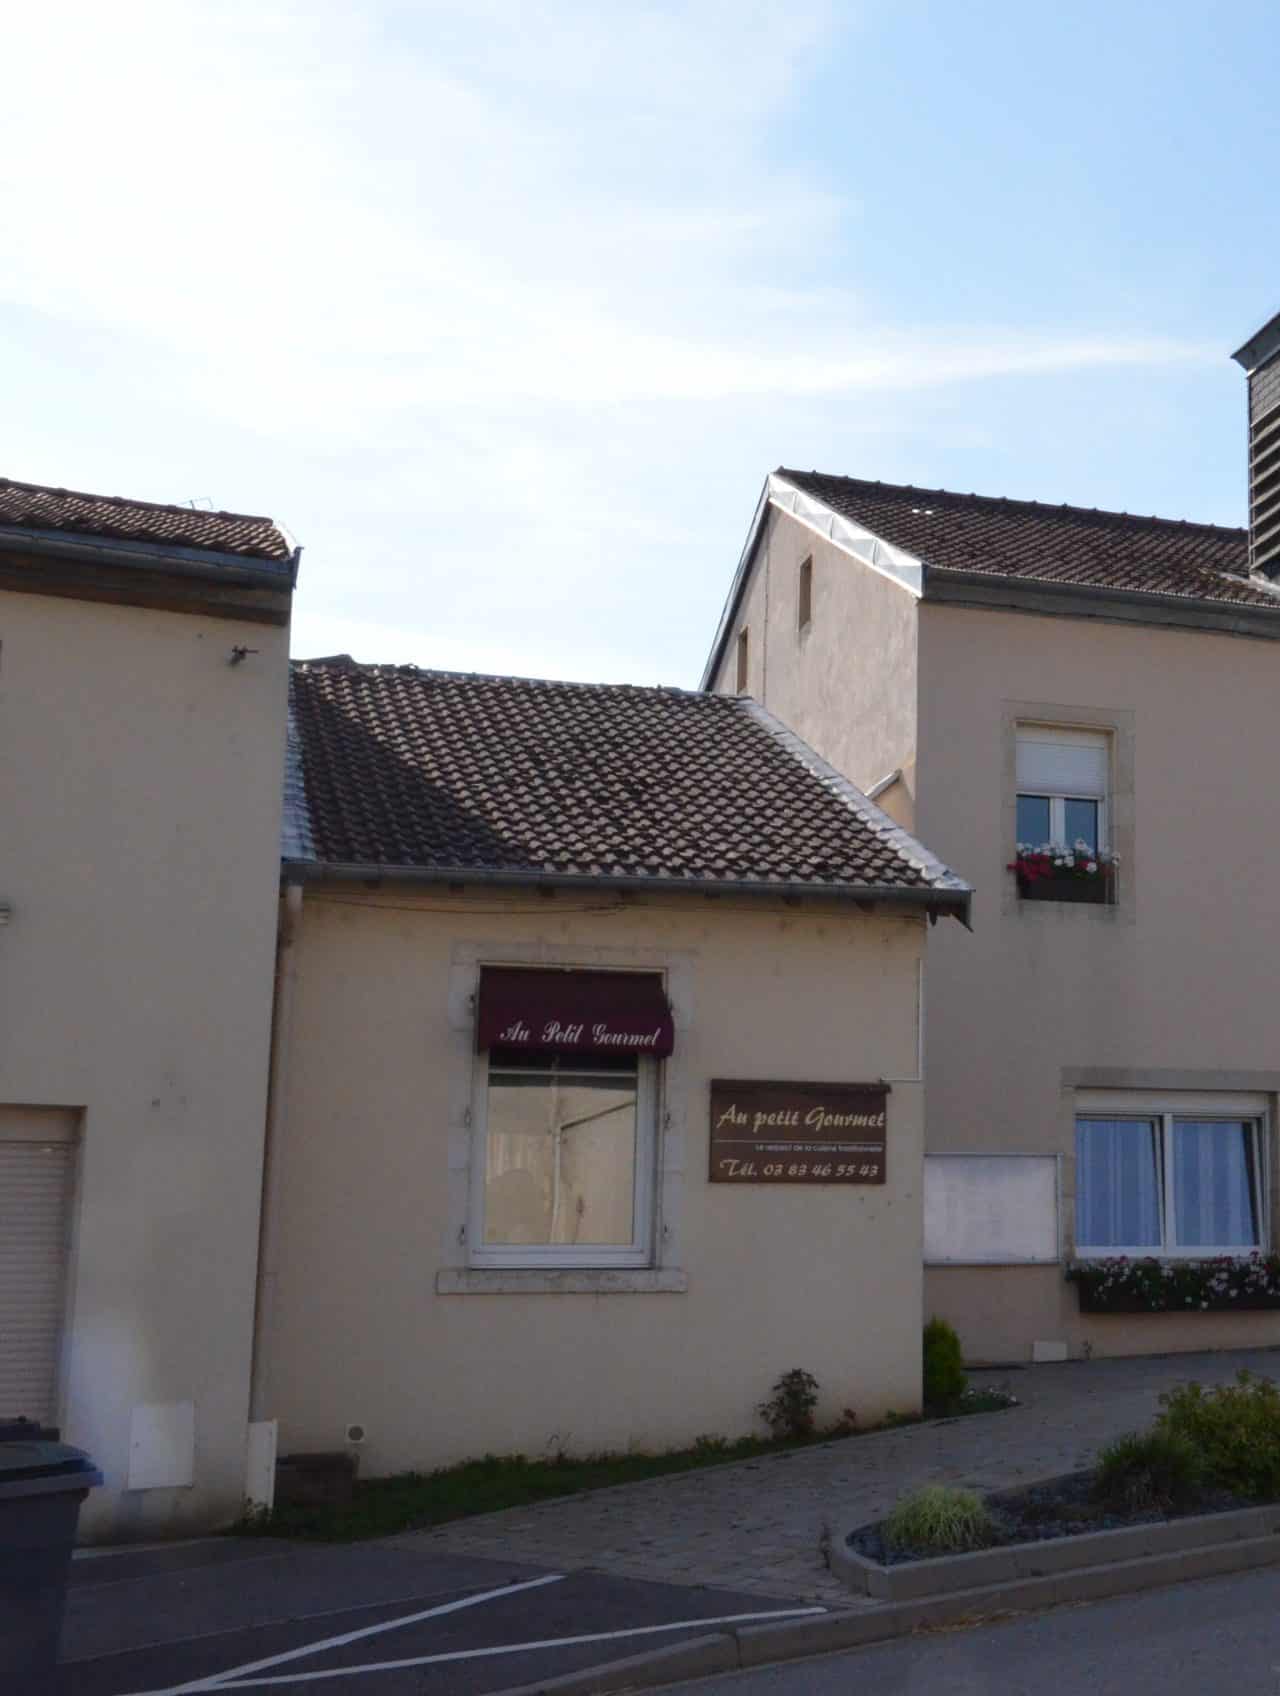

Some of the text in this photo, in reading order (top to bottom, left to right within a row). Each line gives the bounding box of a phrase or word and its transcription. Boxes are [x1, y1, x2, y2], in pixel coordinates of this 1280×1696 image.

[500, 1020, 662, 1047] Au Petit Gourmet
[716, 1104, 885, 1133] Au petit Gourmet
[763, 1162, 785, 1177] 03
[788, 1163, 809, 1177] 83
[812, 1162, 832, 1177] 46
[835, 1163, 857, 1177] 55
[859, 1164, 879, 1177] 43
